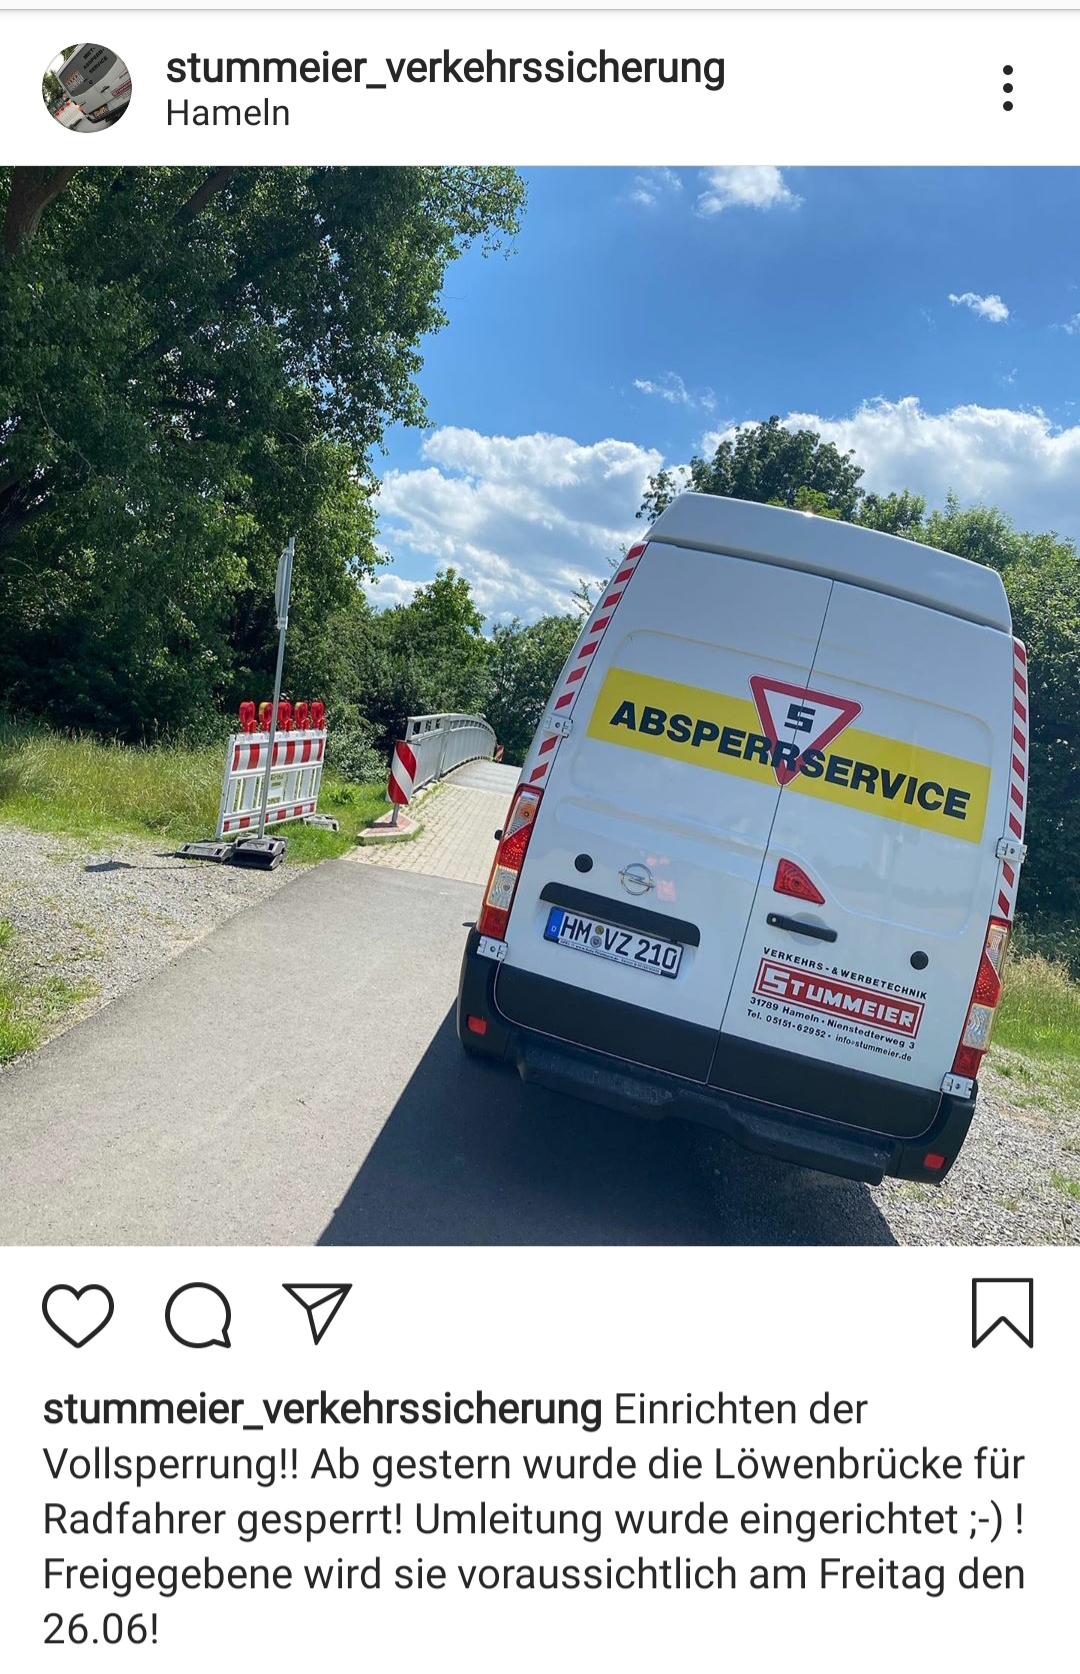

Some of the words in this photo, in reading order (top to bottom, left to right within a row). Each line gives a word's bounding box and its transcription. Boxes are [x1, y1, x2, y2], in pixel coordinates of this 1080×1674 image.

[610, 700, 971, 820] ABSPERRSERVICE
[560, 915, 592, 944] HM
[604, 927, 633, 957] VZ
[634, 938, 678, 970] 210
[762, 967, 915, 1028] STUMMEIER
[840, 968, 928, 1000] WERBETECHNIK
[747, 1008, 762, 1020] Tel.
[750, 996, 779, 1011] 31789
[782, 1005, 819, 1023] Hameln
[827, 1018, 905, 1049] Nienstedterweg
[909, 1041, 916, 1049] 3
